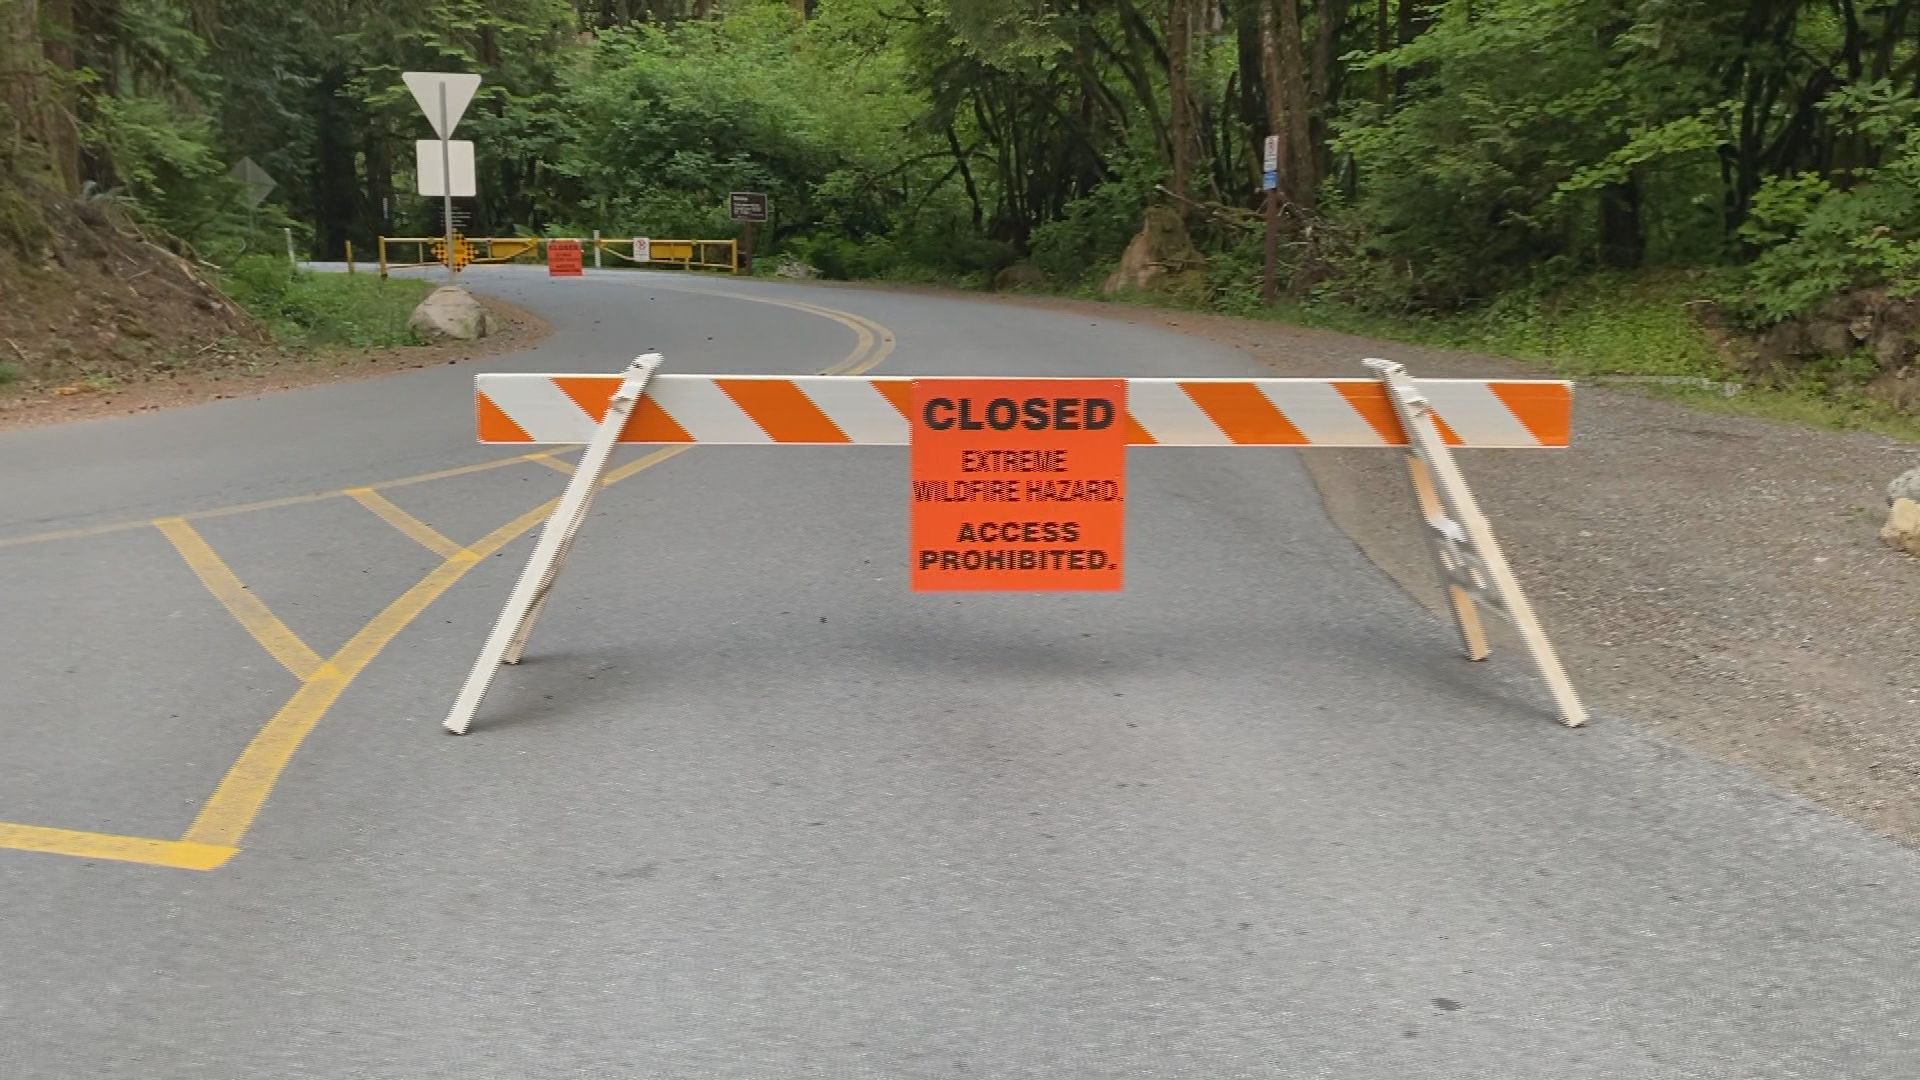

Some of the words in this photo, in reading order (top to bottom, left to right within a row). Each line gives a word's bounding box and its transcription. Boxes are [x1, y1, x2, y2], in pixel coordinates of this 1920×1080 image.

[923, 398, 1115, 430] CLOSED
[962, 450, 1068, 472] EXTREME
[912, 480, 1020, 502] WILDFIRE
[1026, 480, 1124, 502] HAZARD.
[957, 522, 1080, 543] ACCESS
[919, 550, 1117, 571] PROHIBITED.
